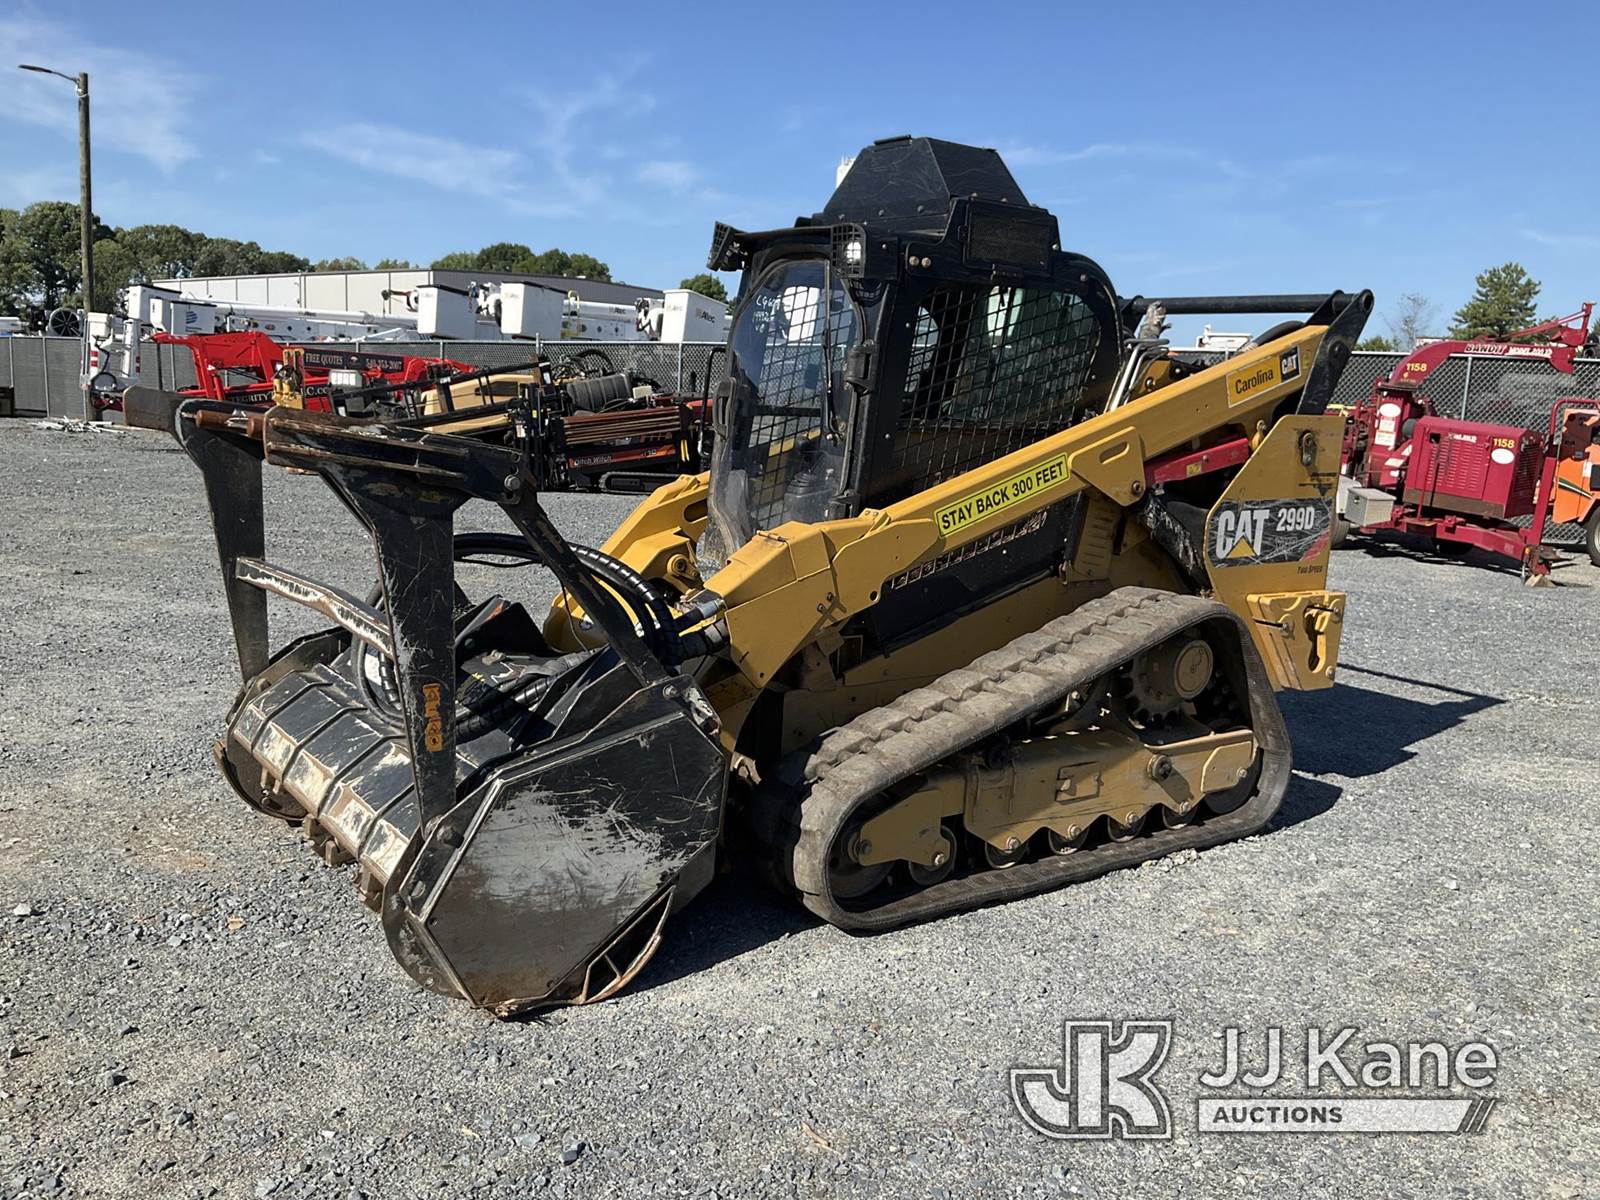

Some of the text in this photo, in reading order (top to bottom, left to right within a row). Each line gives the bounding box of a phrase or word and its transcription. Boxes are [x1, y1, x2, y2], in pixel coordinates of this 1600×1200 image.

[305, 352, 343, 366] FREE QUOTES
[1406, 362, 1428, 372] 1158
[1235, 354, 1297, 394] Carolina CAT
[1493, 438, 1515, 449] 1158
[941, 461, 1065, 530] STAY BACK 300 FEET
[1215, 506, 1315, 560] CAT 299D
